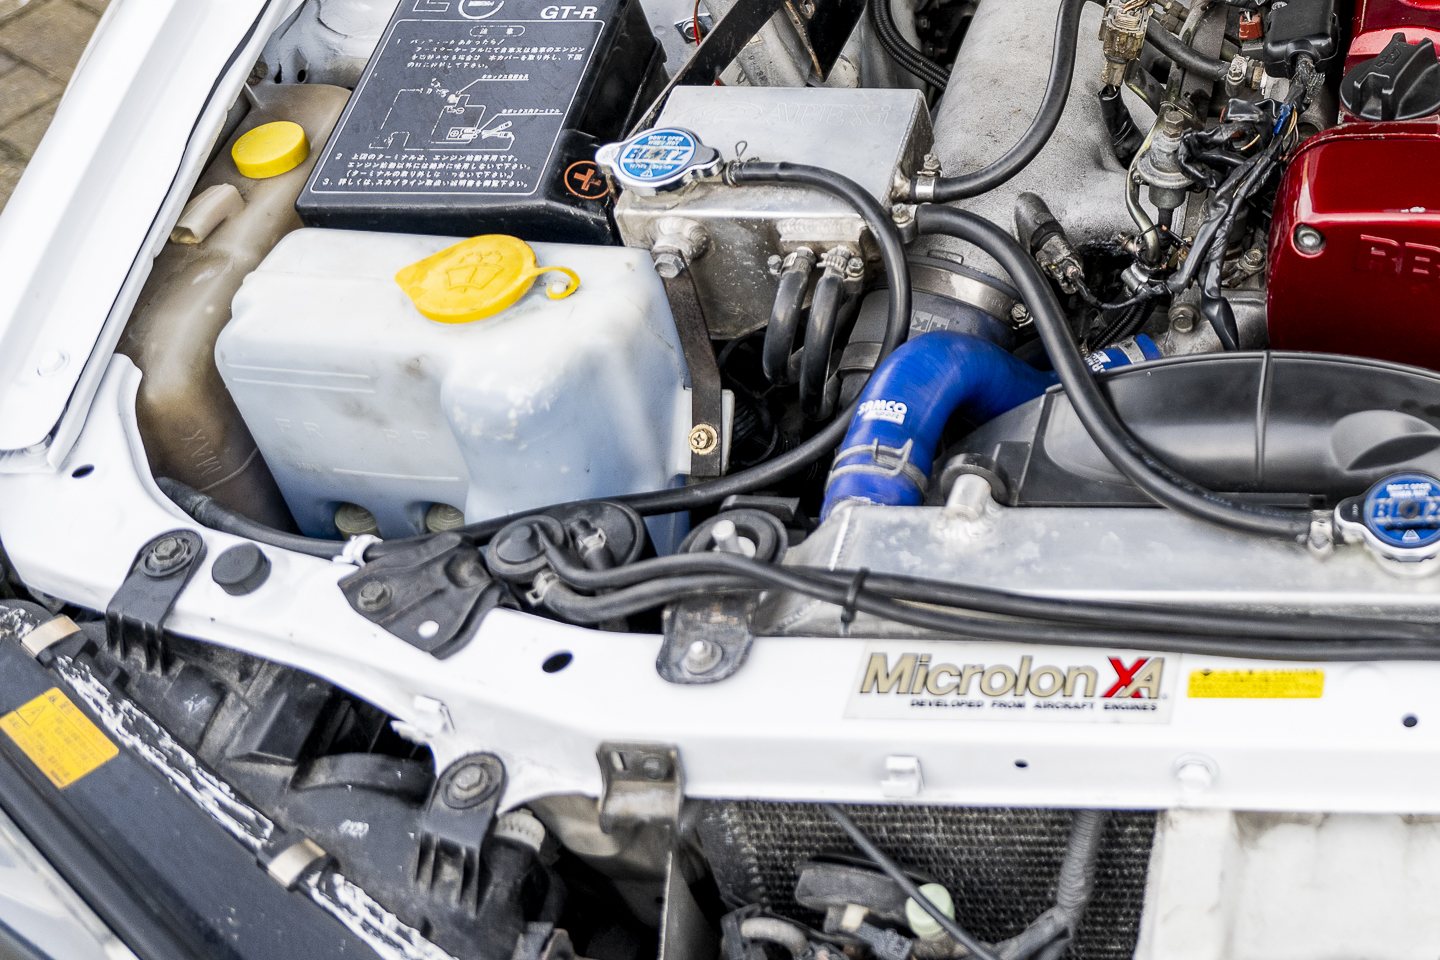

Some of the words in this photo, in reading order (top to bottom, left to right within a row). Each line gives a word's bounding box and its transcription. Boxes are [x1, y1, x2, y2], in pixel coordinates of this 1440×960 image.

[540, 5, 598, 20] GT-R
[857, 399, 908, 417] SAMCO
[859, 652, 1099, 699] Microlon
[910, 698, 985, 708] DEVELOPED
[991, 700, 1026, 709] FROM
[1034, 700, 1096, 710] AIRCRAFT
[1103, 701, 1158, 711] ENGINES
